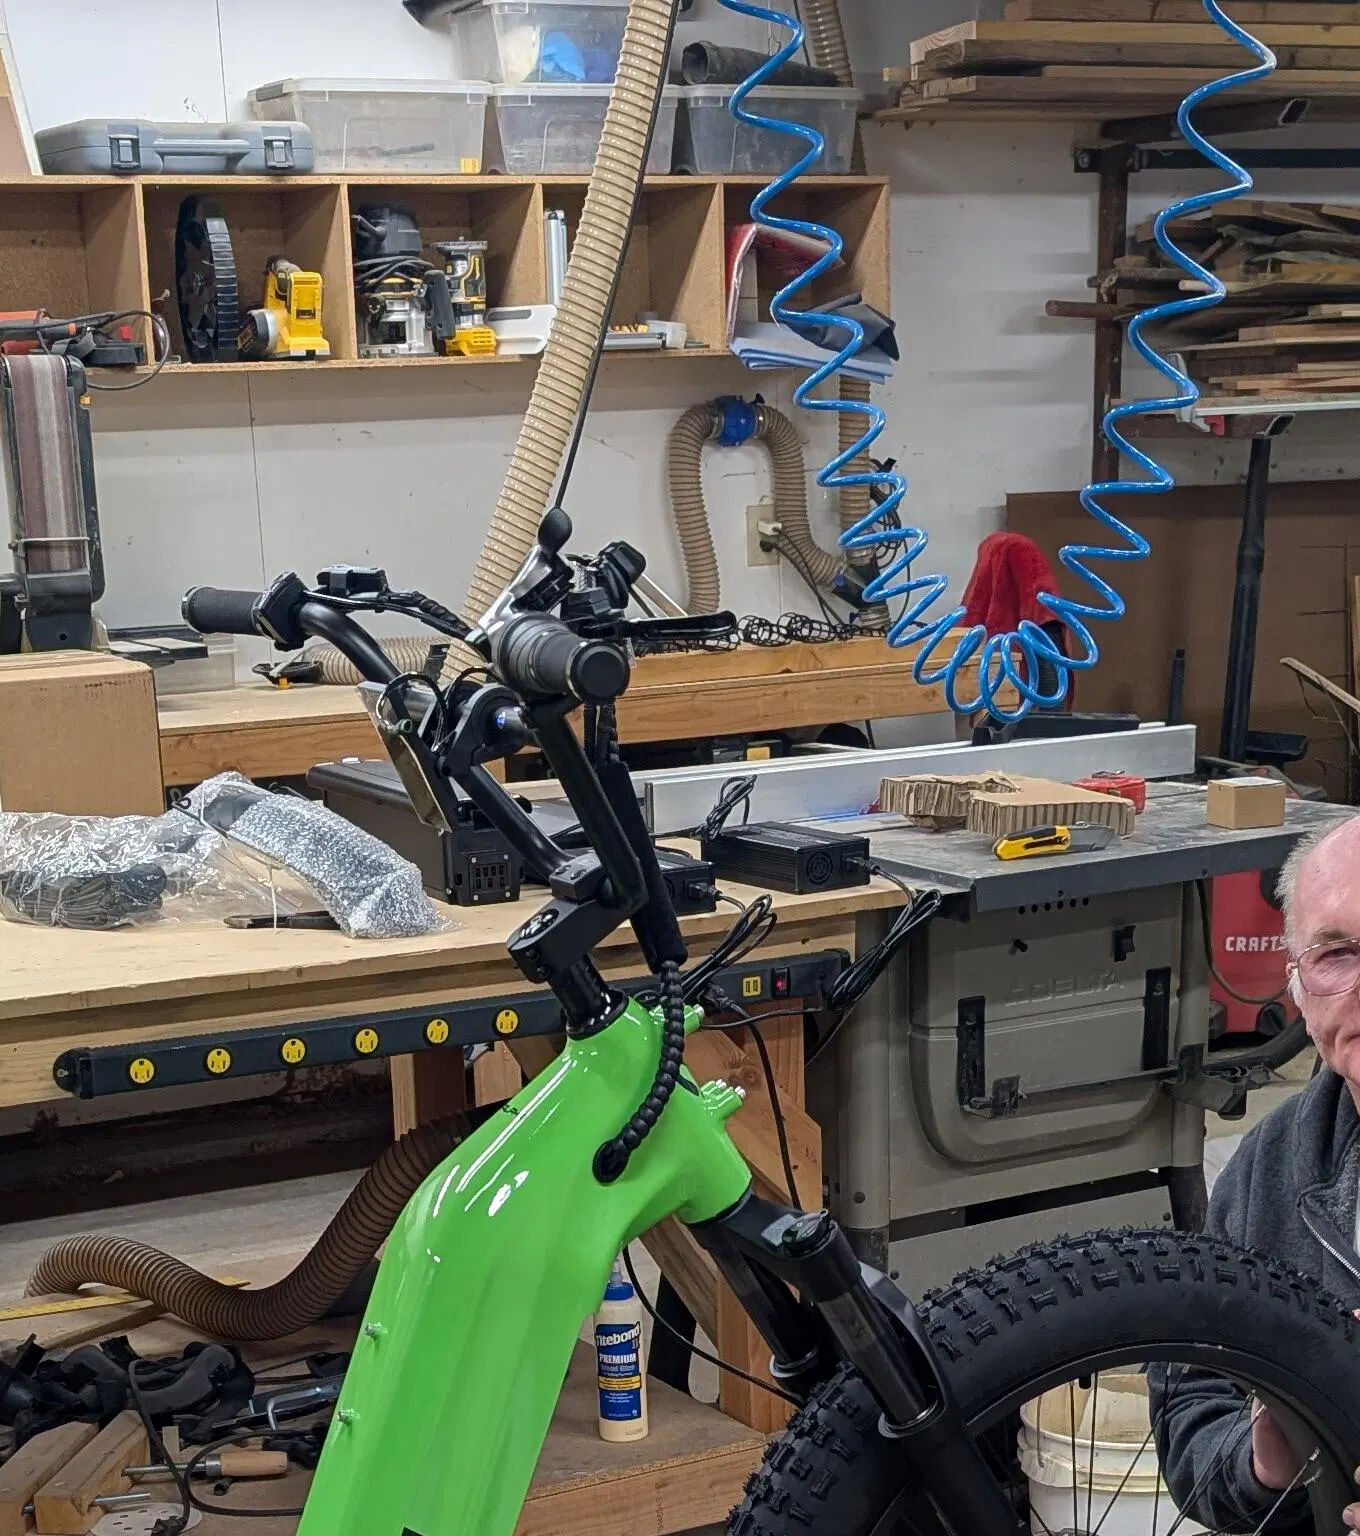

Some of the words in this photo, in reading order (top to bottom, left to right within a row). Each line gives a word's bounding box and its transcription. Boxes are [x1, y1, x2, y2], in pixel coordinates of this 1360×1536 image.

[1225, 935, 1288, 952] CRAFTS
[596, 1322, 640, 1347] Titebond
[599, 1352, 637, 1364] PREMIUM
